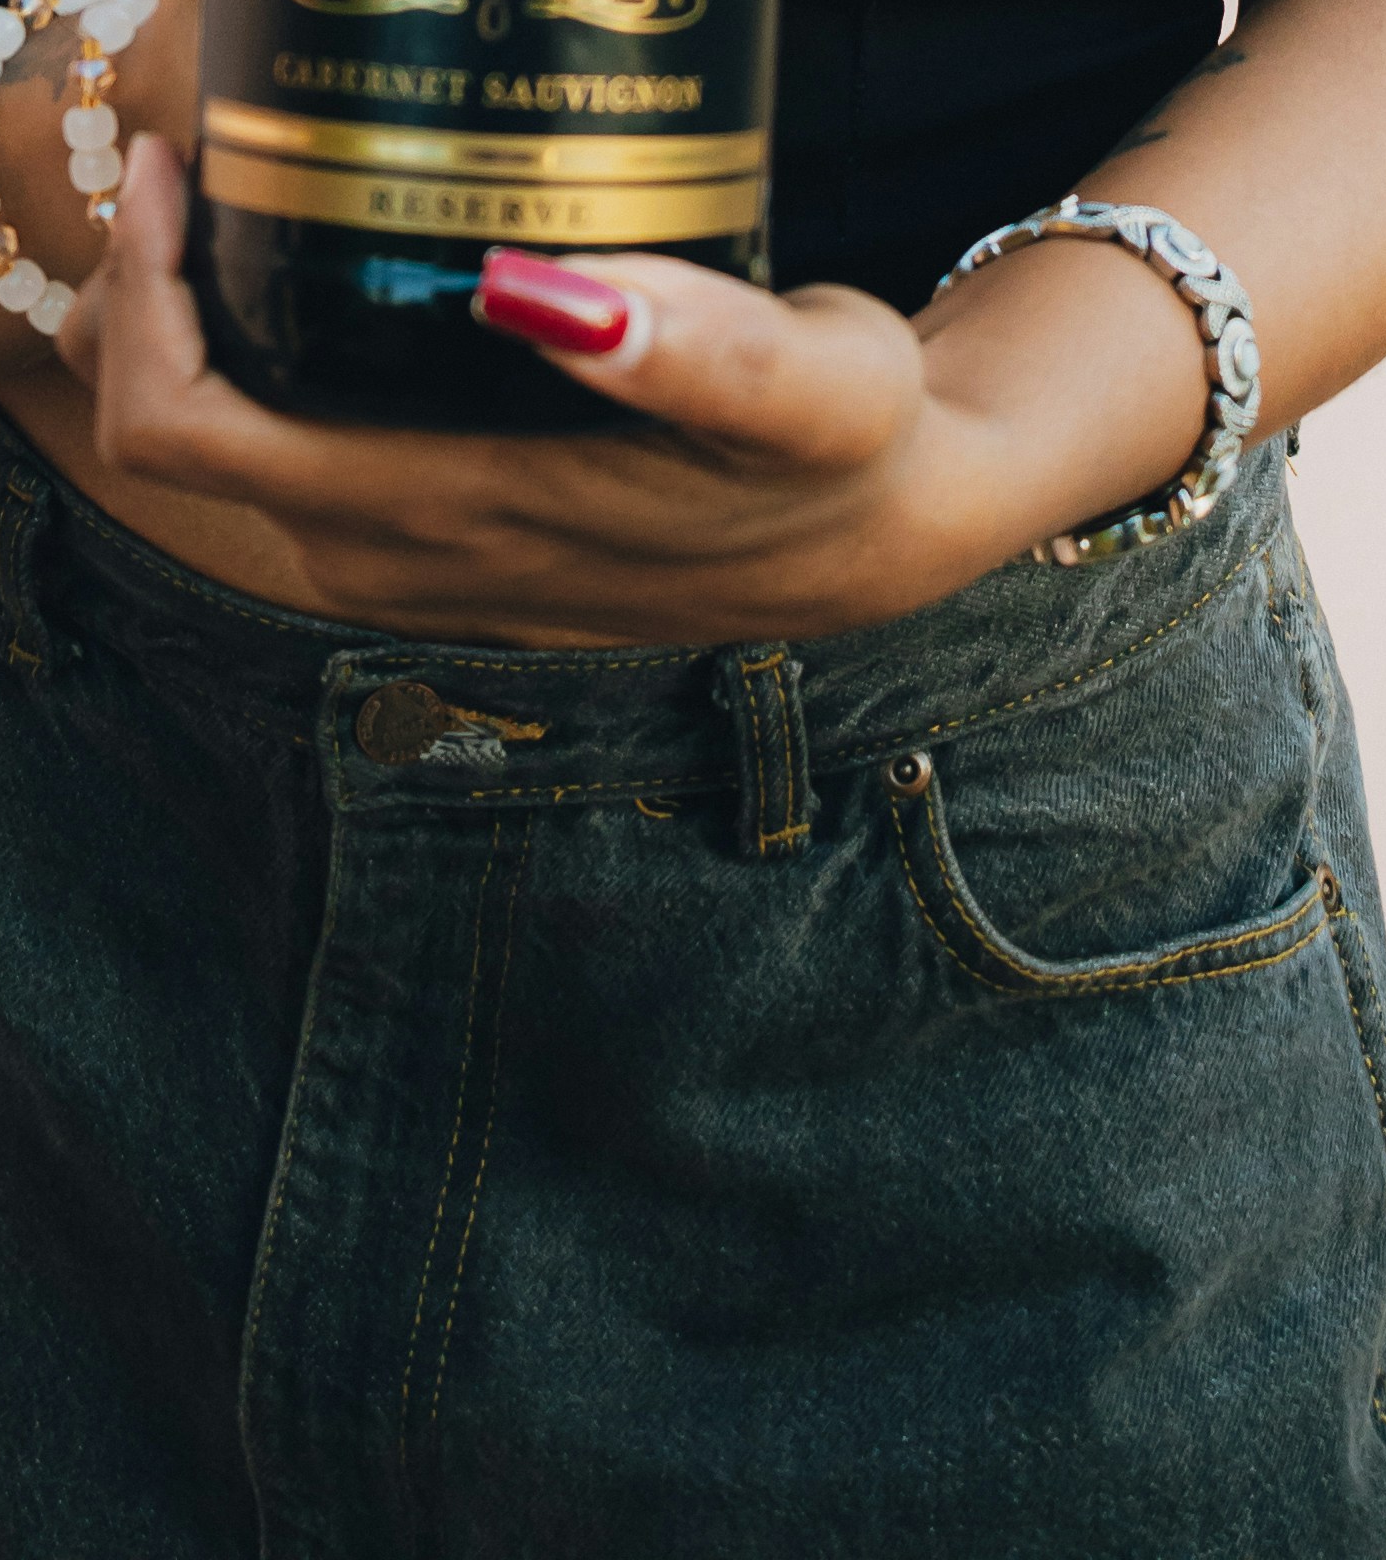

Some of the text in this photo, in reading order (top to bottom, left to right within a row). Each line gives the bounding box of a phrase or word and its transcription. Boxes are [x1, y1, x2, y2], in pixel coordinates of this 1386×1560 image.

[271, 51, 703, 114] CABERNET SAUVIGNON
[368, 186, 594, 229] RESERVE
